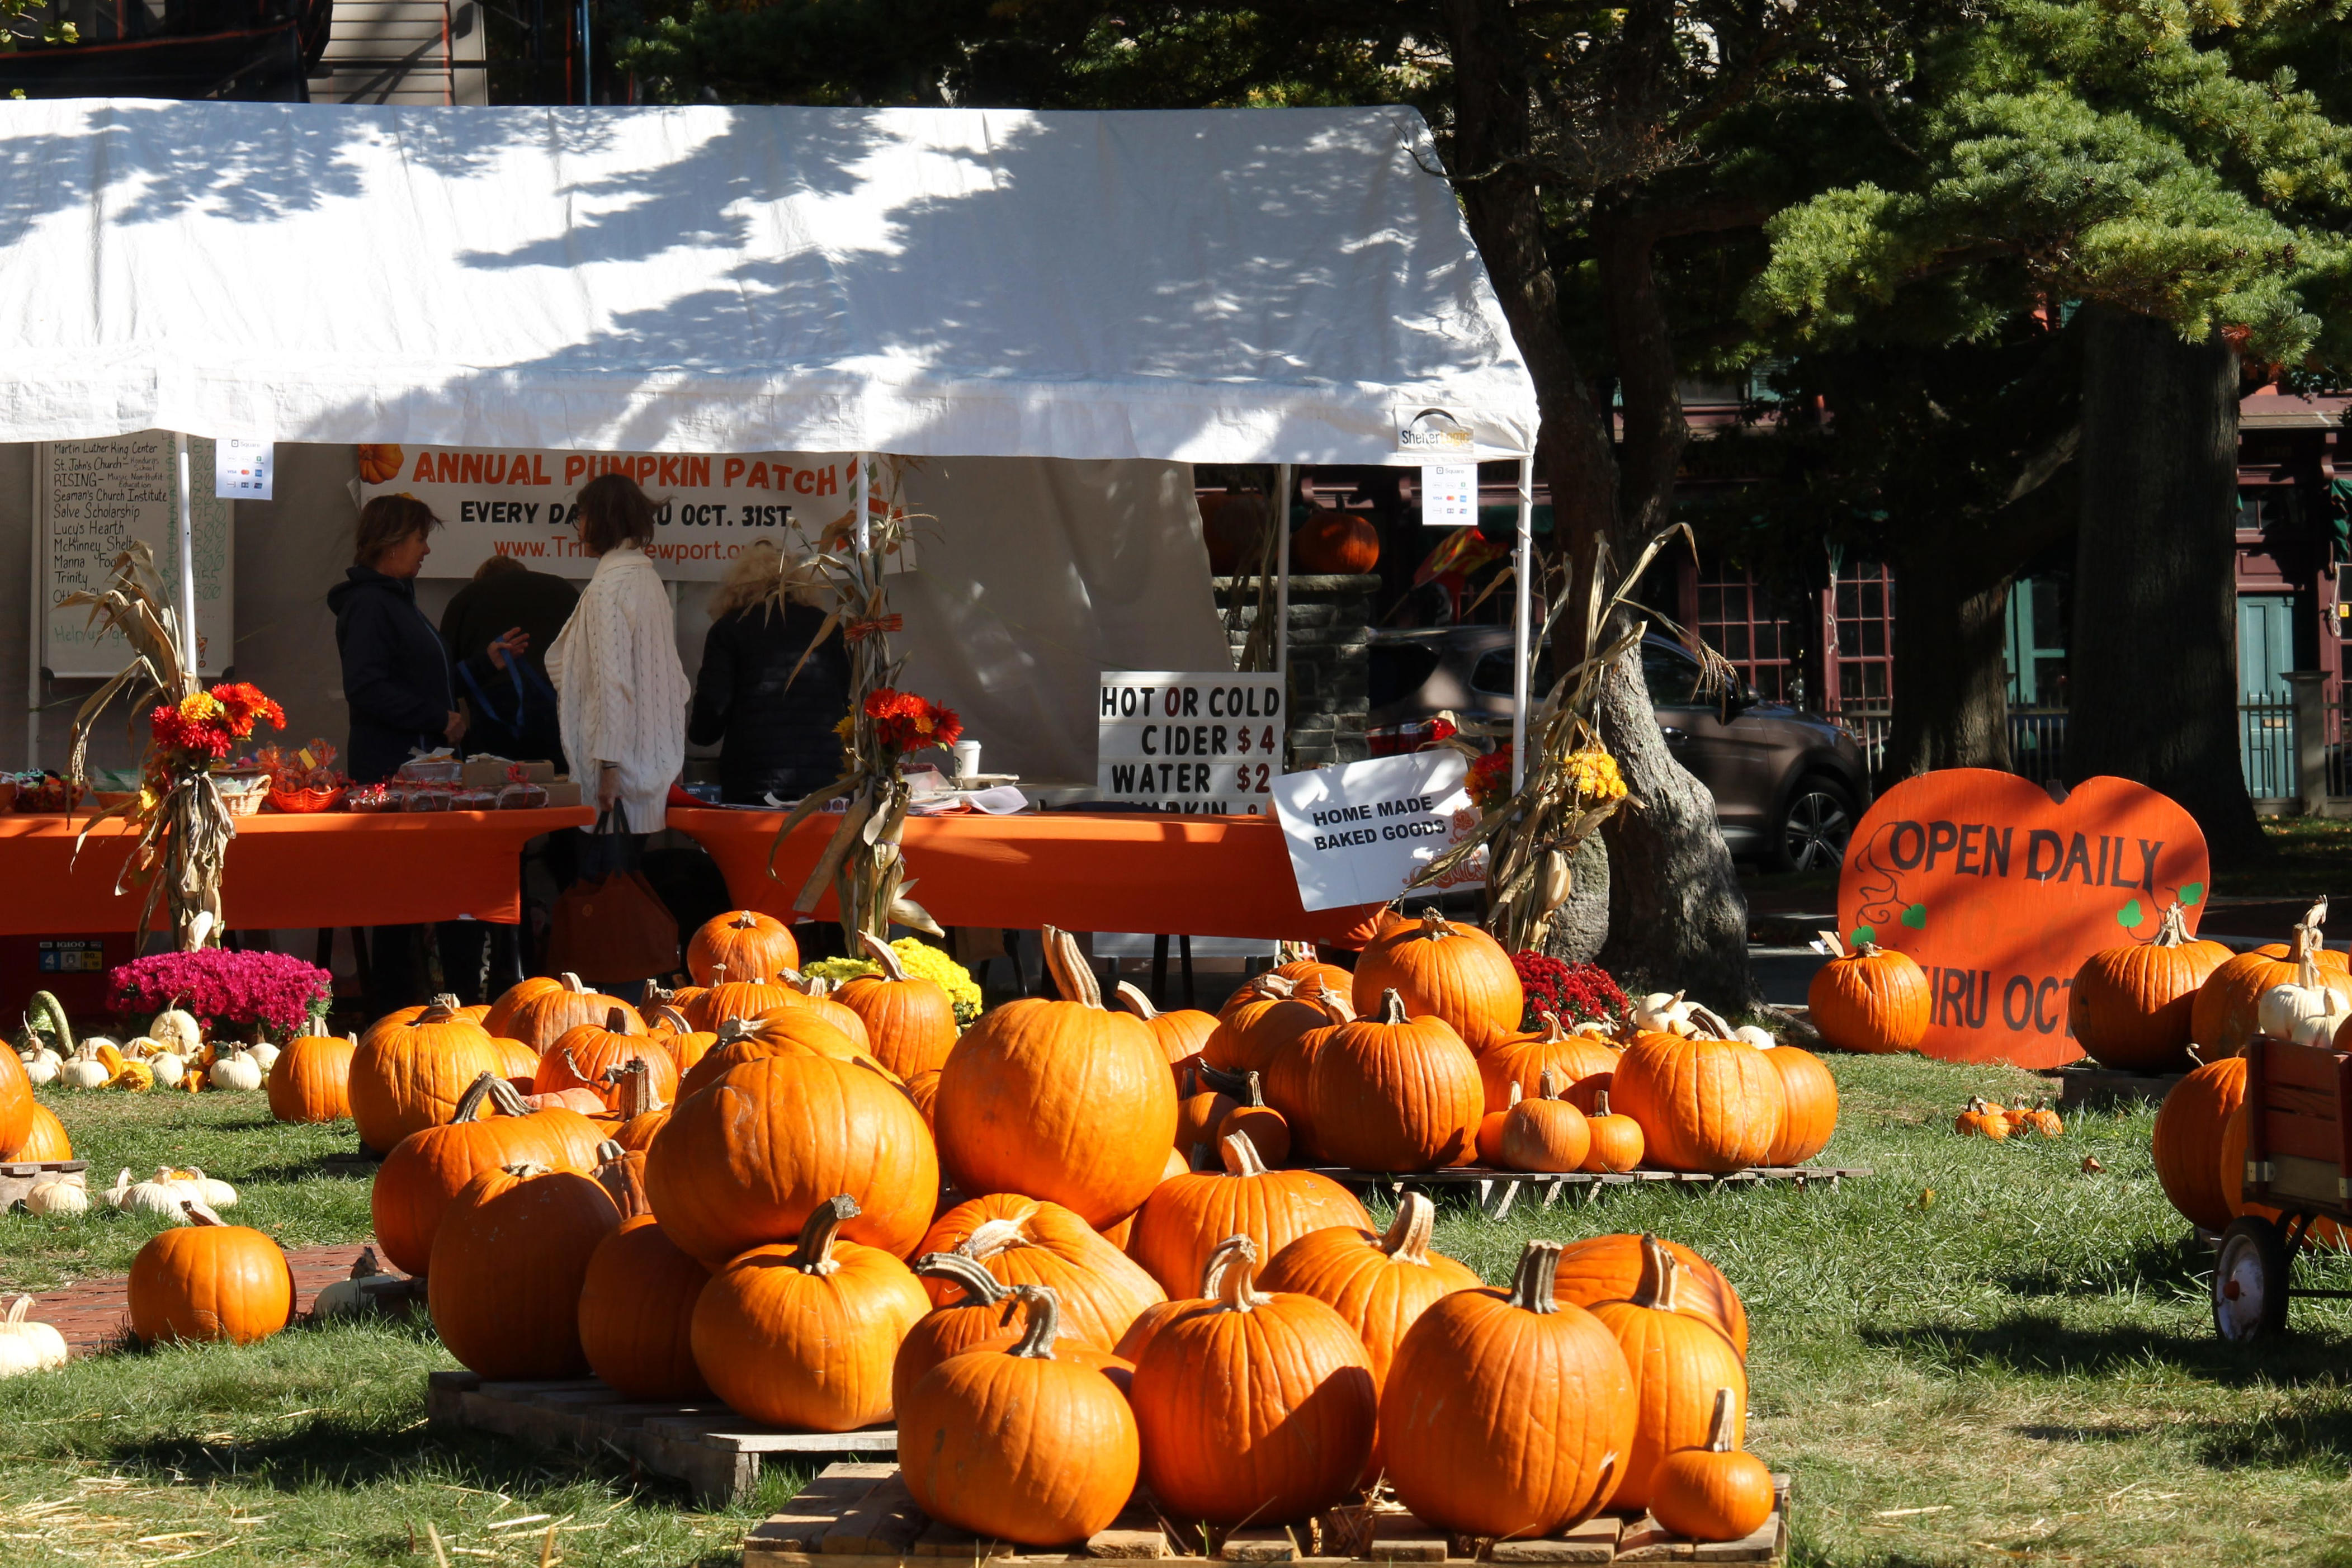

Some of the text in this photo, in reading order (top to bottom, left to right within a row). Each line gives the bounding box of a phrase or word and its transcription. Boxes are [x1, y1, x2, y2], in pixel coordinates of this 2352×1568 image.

[1401, 429, 1471, 447] ShelterLogic
[54, 443, 79, 454] Martin
[83, 442, 108, 453] Luther
[111, 442, 129, 460] King
[132, 442, 158, 454] Center
[54, 459, 67, 471] St.
[69, 459, 92, 471] John's
[130, 456, 159, 465] Honduras
[131, 473, 163, 481] Non-Profit
[412, 452, 837, 497] ANNUAL PUMPKIN PATCH
[54, 489, 93, 502] Seaman's
[96, 488, 125, 502] Church
[127, 488, 167, 502] Institute
[54, 503, 79, 518] Salve
[84, 502, 140, 522] Scholarship
[461, 501, 540, 523] EVERY
[549, 503, 578, 525] DA
[681, 504, 733, 527] OCT.
[742, 505, 792, 527] 31ST
[54, 521, 84, 542] Lucy's
[89, 521, 124, 535] Hearth
[54, 537, 101, 560] McKinney
[107, 535, 132, 551] Shelt
[54, 555, 85, 569] Manna
[98, 552, 121, 568] Foo
[55, 570, 88, 591] Trinity
[54, 624, 84, 645] Help
[1102, 687, 1279, 717] HOT OR COLD
[1141, 725, 1227, 755] CIDER
[1112, 763, 1211, 793] WATER
[1312, 796, 1434, 826] HOME MADE
[1314, 819, 1447, 851] BAKED GOODS
[1889, 820, 2166, 894] OPEN DAILY
[45, 954, 54, 965] 4
